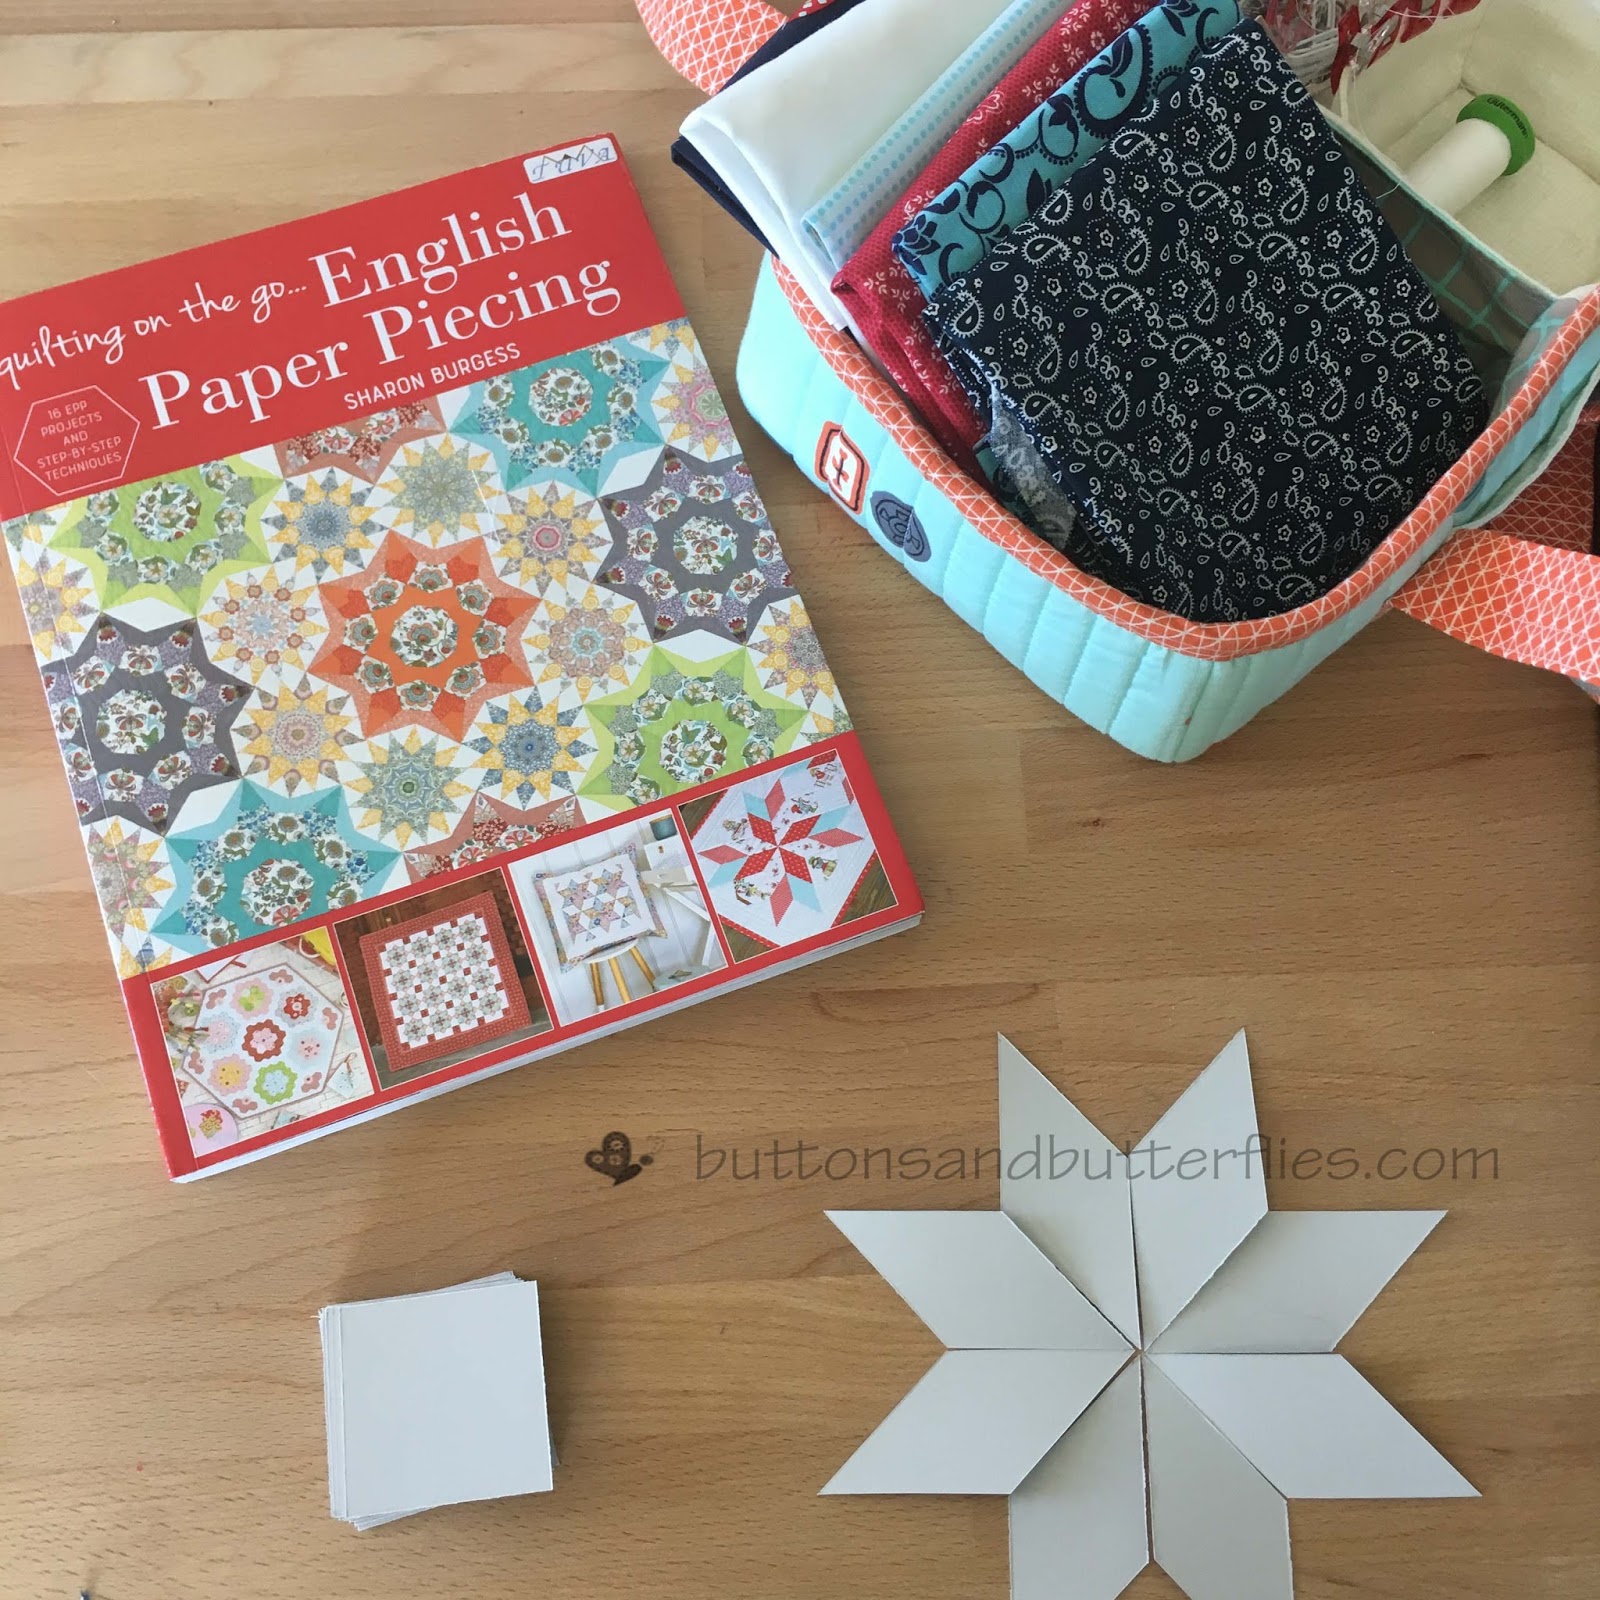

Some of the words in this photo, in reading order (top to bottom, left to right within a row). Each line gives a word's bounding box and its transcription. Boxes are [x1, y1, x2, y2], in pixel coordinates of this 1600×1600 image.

[0, 326, 126, 390] quilting
[134, 315, 171, 336] on
[179, 282, 241, 322] the
[308, 192, 573, 308] English
[138, 341, 349, 430] Paper
[363, 260, 621, 365] Piecing
[344, 373, 425, 410] SHARON
[431, 343, 521, 383] BURGESS
[41, 411, 103, 437] PROJECTS
[48, 407, 62, 420] 16
[65, 400, 88, 416] EPP
[37, 435, 122, 469] STEP-BY-STEP
[63, 430, 88, 446] AND
[45, 451, 122, 481] TECHNIQUES
